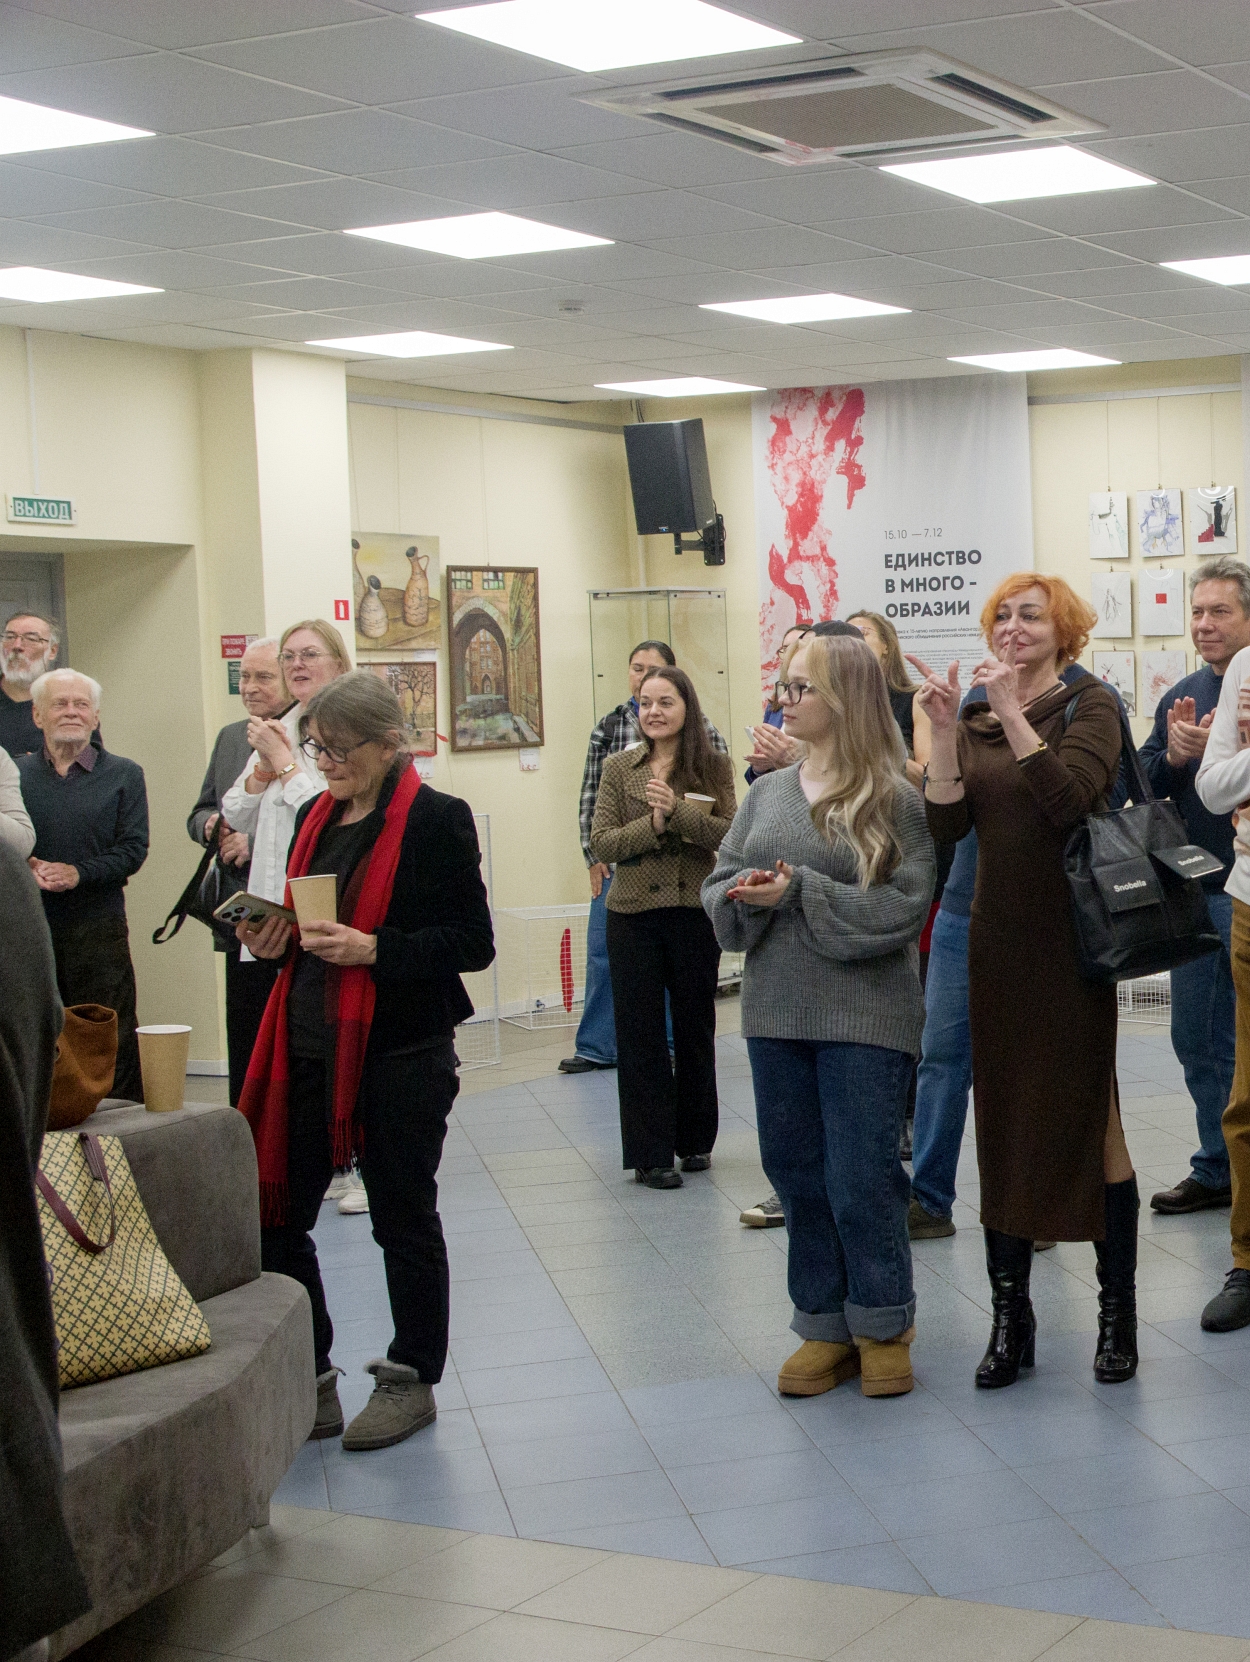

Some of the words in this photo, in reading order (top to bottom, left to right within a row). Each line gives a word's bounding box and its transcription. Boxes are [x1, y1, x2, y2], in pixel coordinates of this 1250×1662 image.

[14, 500, 69, 520] ВЫХОД
[884, 529, 907, 540] 15.10
[924, 527, 943, 538] 7.12
[884, 549, 982, 571] ЕДИНСТВО
[885, 579, 896, 594] В
[900, 575, 965, 593] МНОГО
[885, 600, 970, 618] ОБРАЗИИ
[1113, 880, 1147, 893] Snobella
